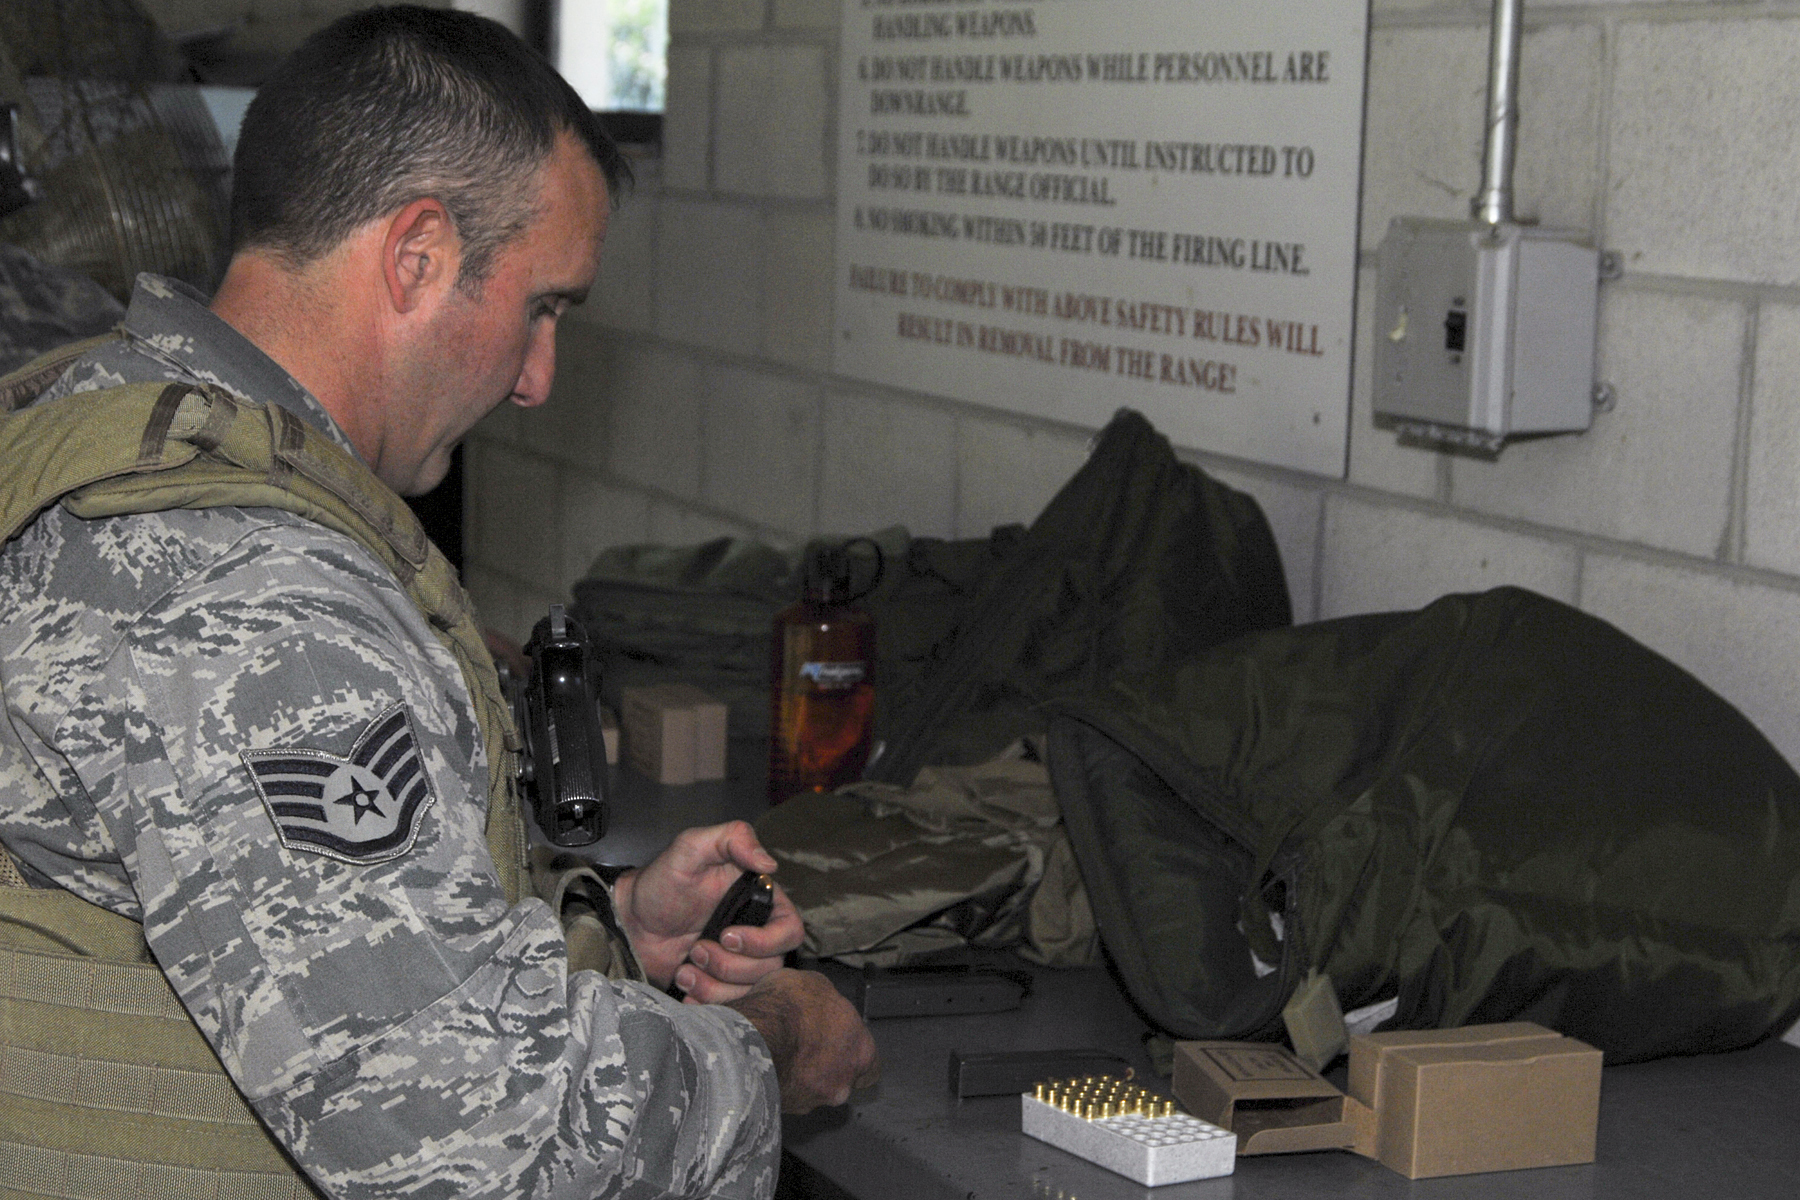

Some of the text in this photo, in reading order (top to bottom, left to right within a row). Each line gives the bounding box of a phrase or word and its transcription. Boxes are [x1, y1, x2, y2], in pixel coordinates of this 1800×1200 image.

[931, 54, 995, 82] HANDLE
[1000, 53, 1084, 82] WEAPONS
[1086, 53, 1149, 83] WHILE
[1153, 52, 1277, 82] PERSONNEL
[1281, 51, 1330, 83] ARE
[926, 132, 992, 161] HANDLE
[995, 134, 1078, 166] WEAPONS
[1080, 138, 1139, 169] UNTIL
[1143, 140, 1277, 177] INSTRUCTED
[1281, 145, 1315, 179] TO
[971, 169, 1027, 198] RANGE
[1029, 173, 1116, 206] OFFICIAL.
[962, 214, 1026, 248] WITHIN
[1050, 221, 1096, 254] FEET
[1097, 225, 1124, 257] OF
[1127, 228, 1168, 262] THE
[1172, 232, 1246, 269] FIRING
[1250, 239, 1310, 276] LINE.
[1002, 283, 1050, 317] WITH
[1054, 291, 1111, 326] ABOVE
[1116, 299, 1189, 338] SAFETY
[1192, 308, 1262, 347] RULES
[1265, 317, 1325, 357] WILL
[979, 323, 1055, 363] REMOVAL
[1059, 337, 1111, 373] FROM
[1116, 345, 1156, 382] THE
